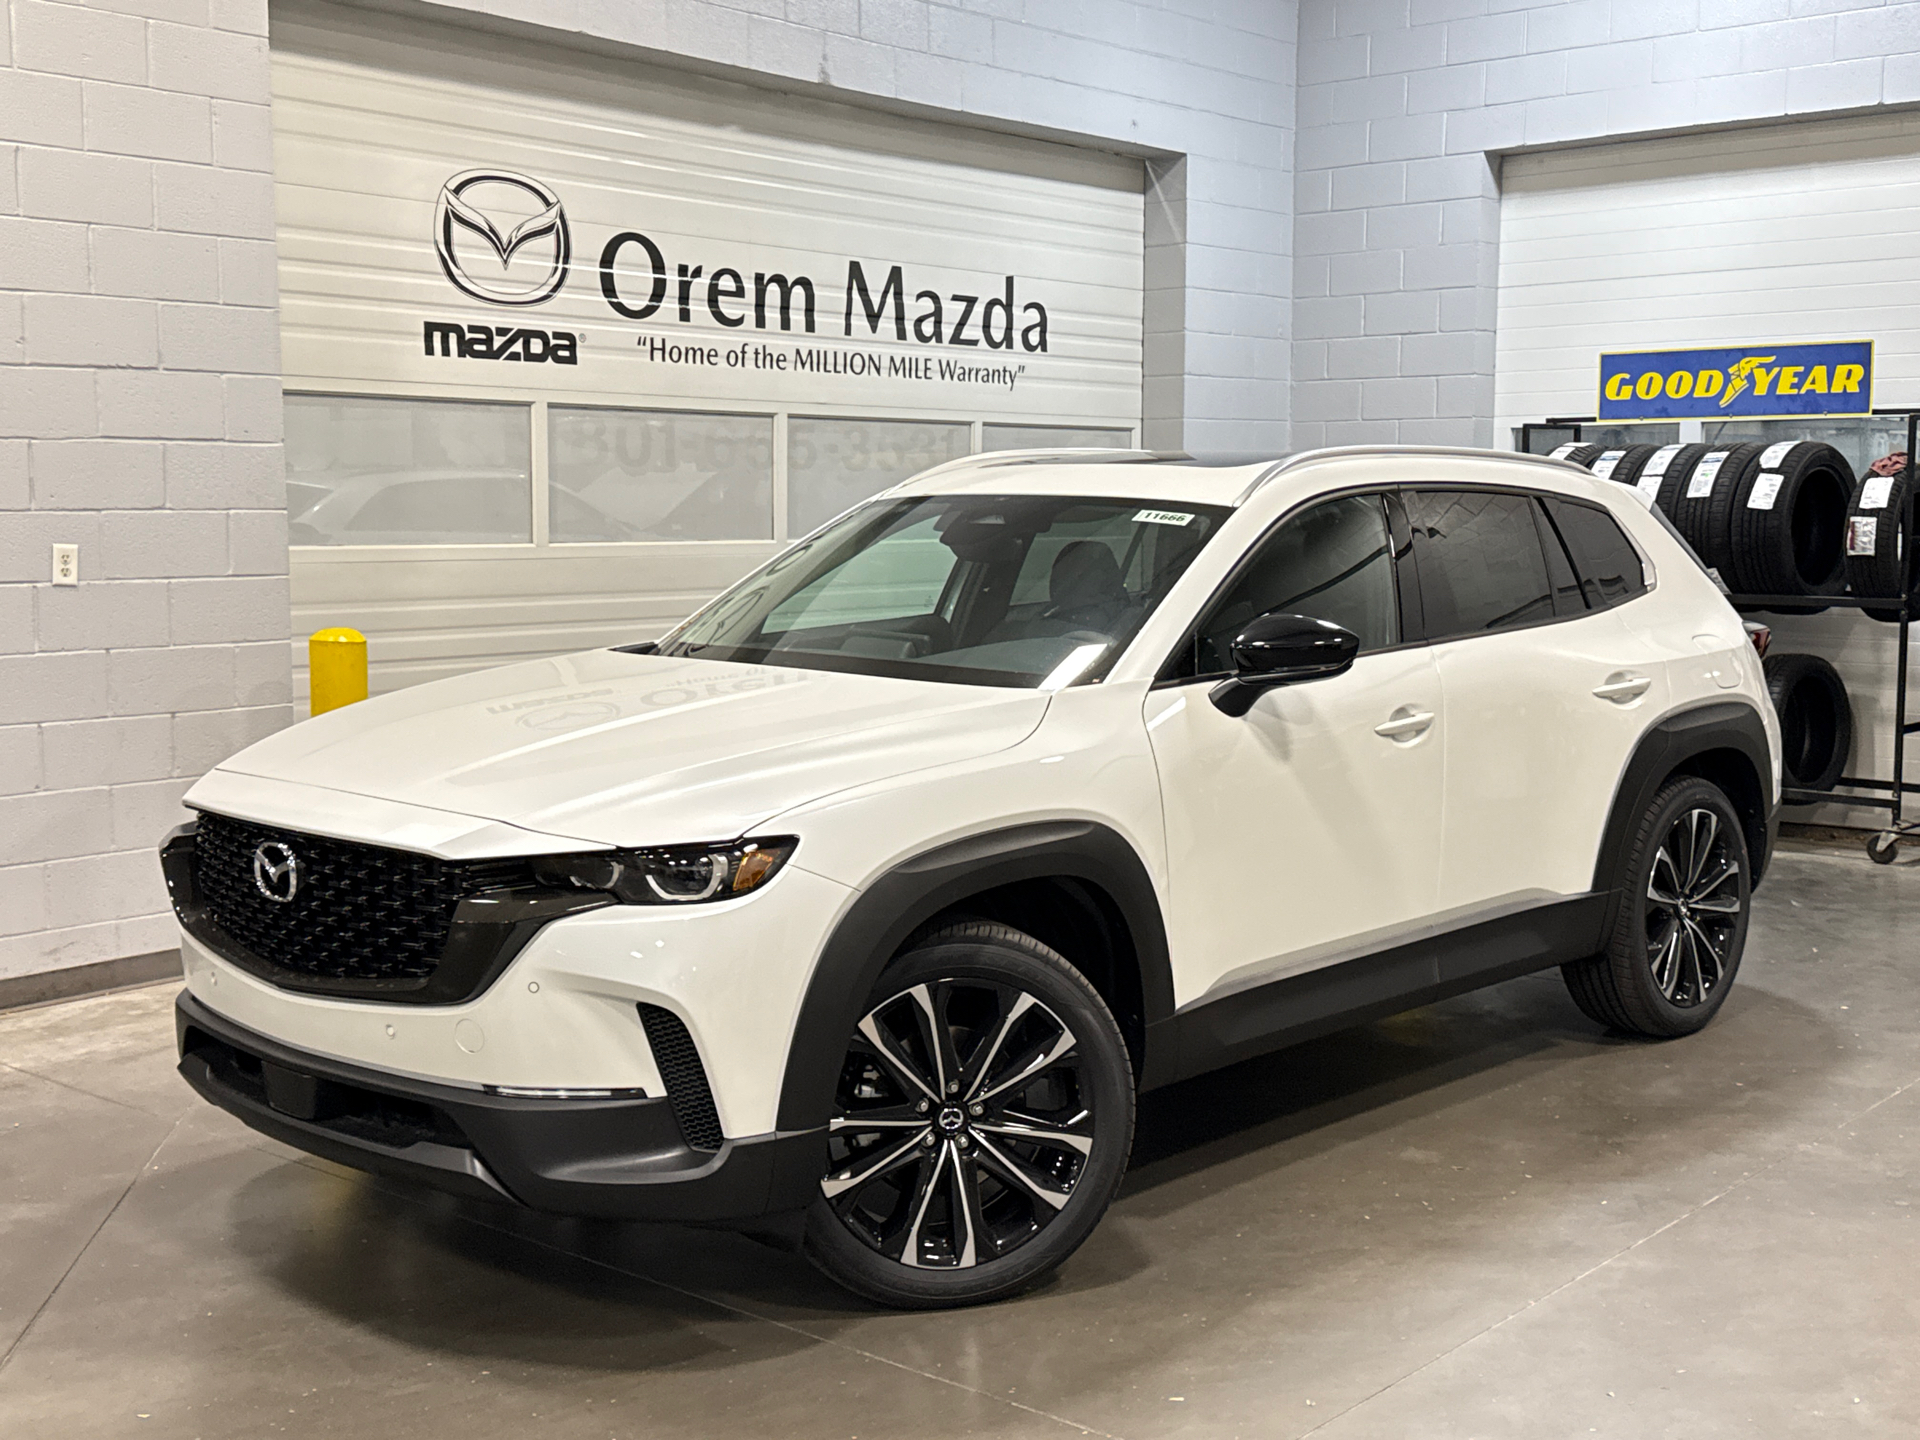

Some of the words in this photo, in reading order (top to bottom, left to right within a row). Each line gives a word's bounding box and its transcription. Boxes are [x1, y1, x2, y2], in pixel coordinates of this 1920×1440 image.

[599, 231, 816, 333] Orem
[844, 260, 1049, 353] Mazda
[726, 343, 749, 368] of
[754, 344, 787, 371] the
[793, 348, 882, 377] MILLION
[888, 355, 933, 380] MILE
[1605, 369, 1724, 401] GOOD
[1752, 364, 1865, 396] YEAR
[1144, 511, 1188, 522] 11666
